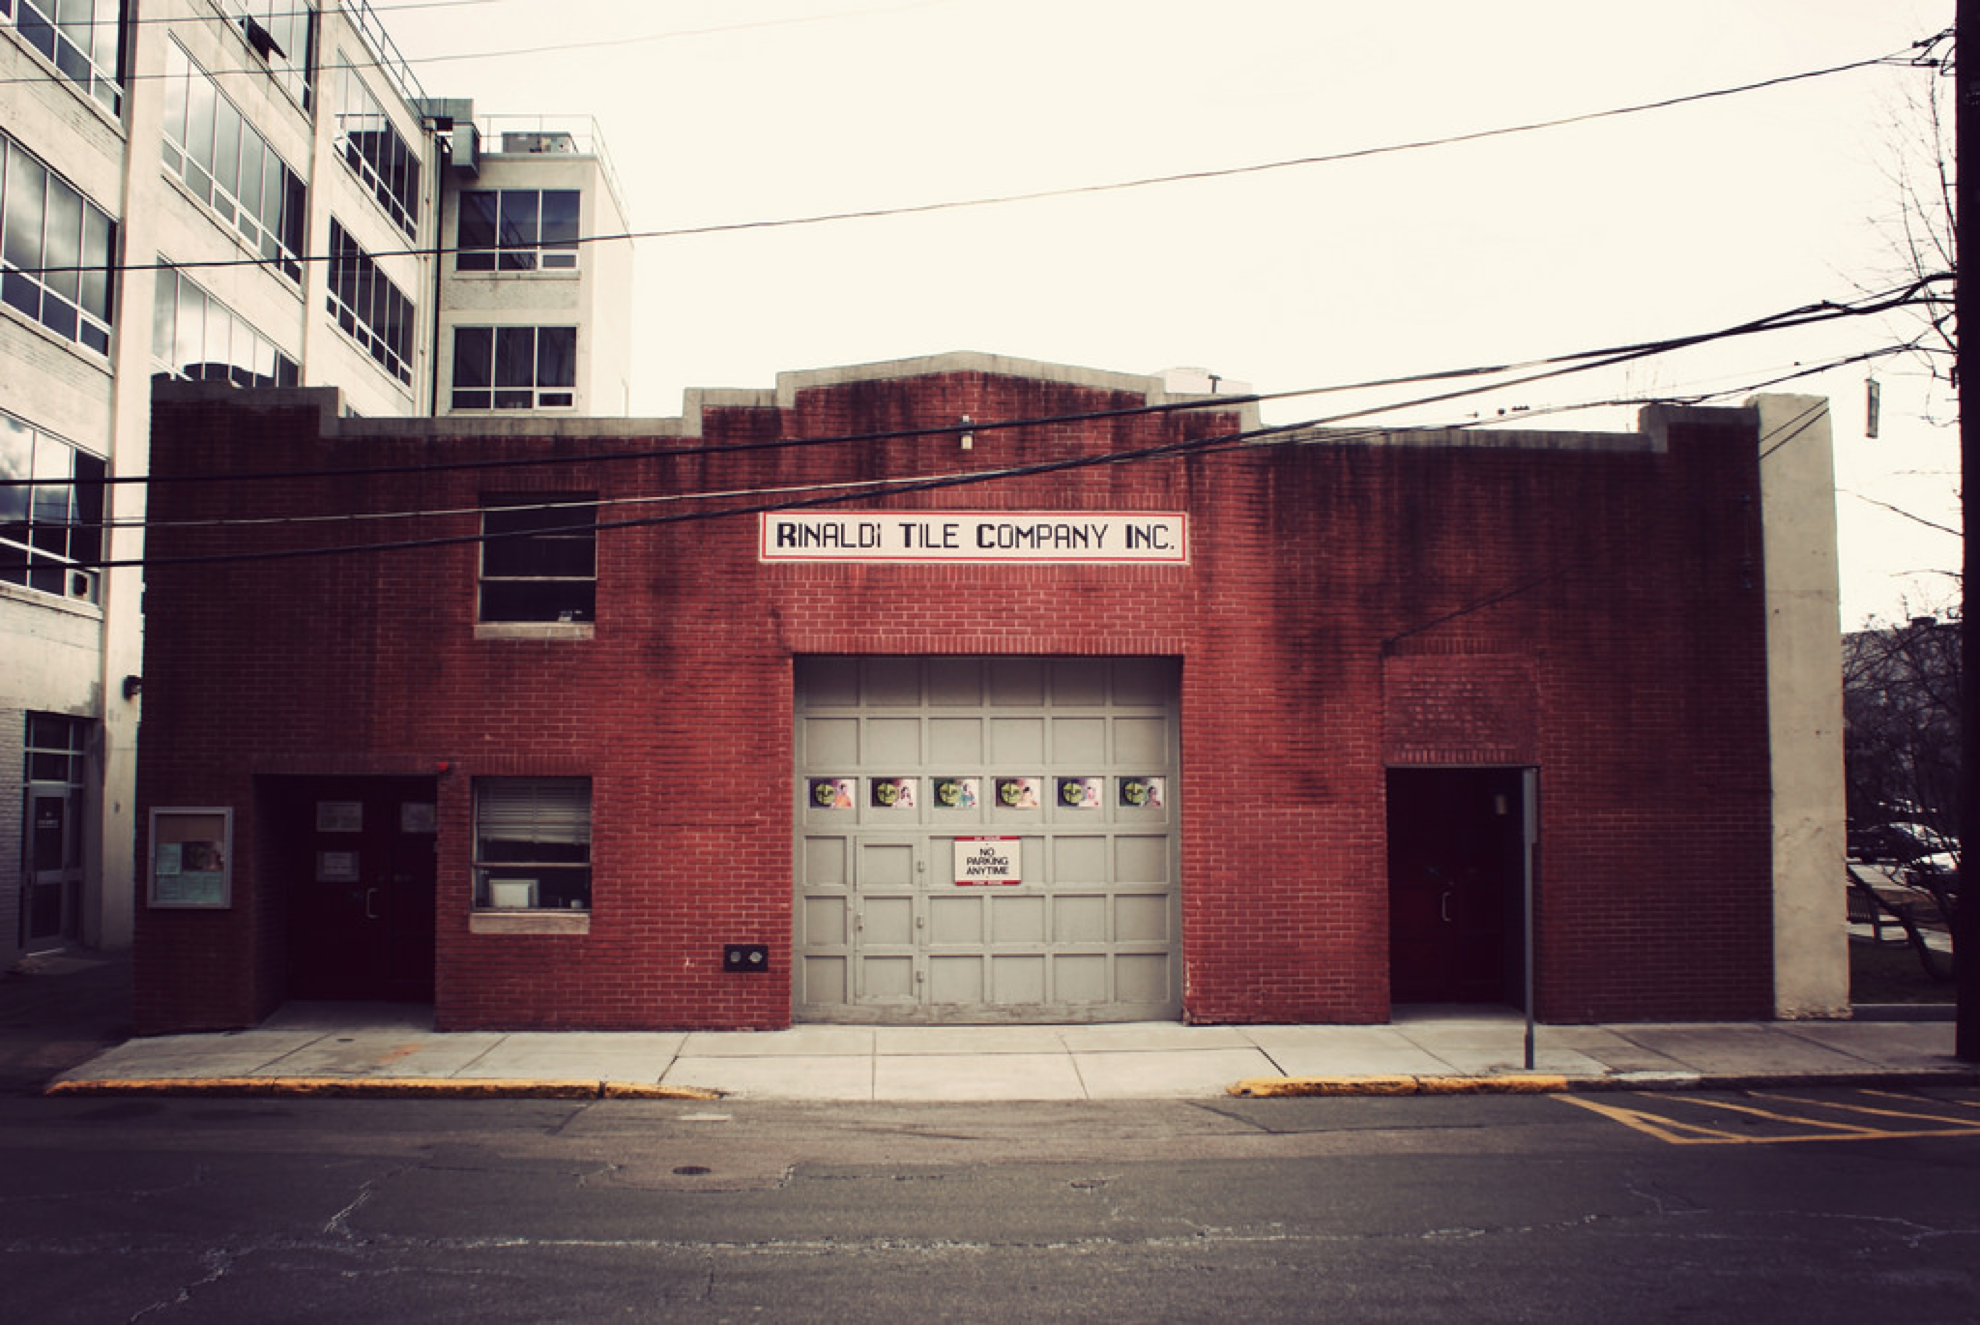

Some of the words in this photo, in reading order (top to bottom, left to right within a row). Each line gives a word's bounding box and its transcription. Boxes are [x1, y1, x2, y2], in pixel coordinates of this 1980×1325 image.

[899, 523, 960, 549] TILE
[976, 523, 1109, 550] COMPANY
[1125, 524, 1175, 550] INC.
[979, 847, 995, 857] NO
[966, 857, 1009, 866] PARKING
[966, 866, 1009, 875] ANYTIME
